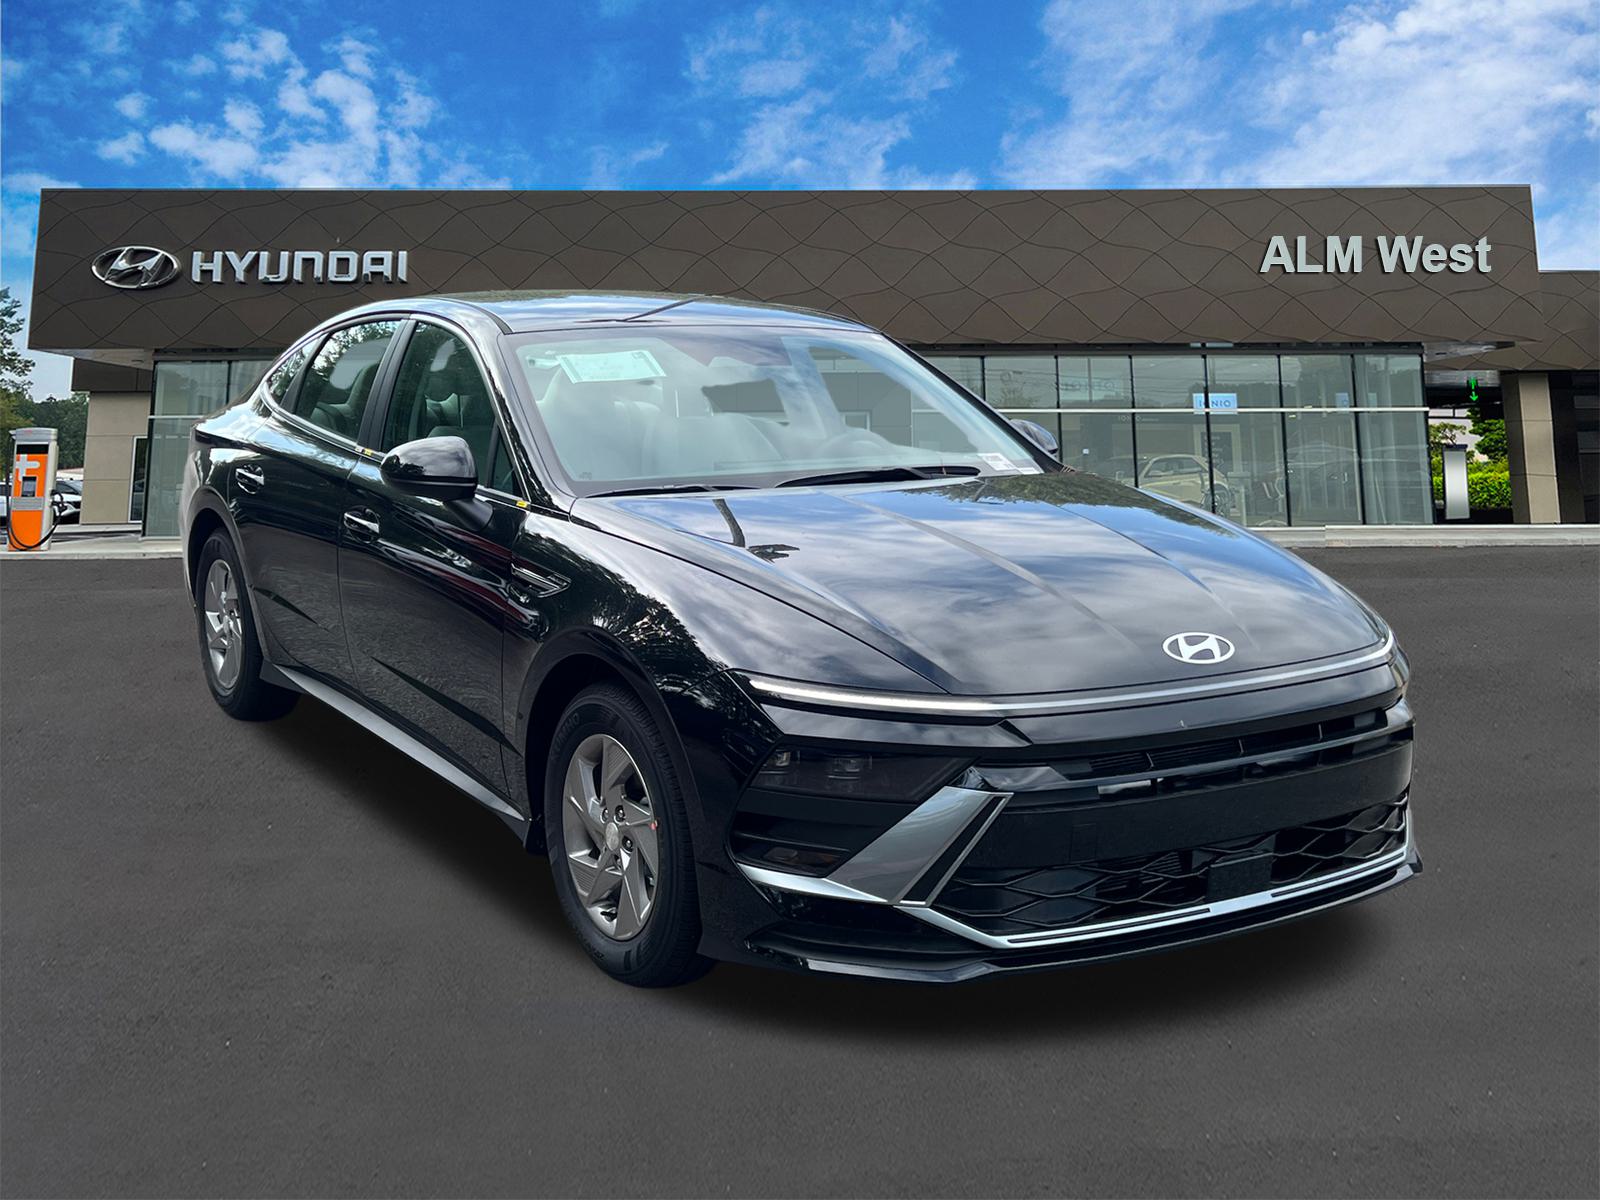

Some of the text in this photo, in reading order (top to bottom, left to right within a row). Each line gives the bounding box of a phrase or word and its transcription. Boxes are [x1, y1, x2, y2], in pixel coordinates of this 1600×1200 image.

[191, 250, 408, 283] HYUNDAI
[1259, 235, 1492, 273] ALM West
